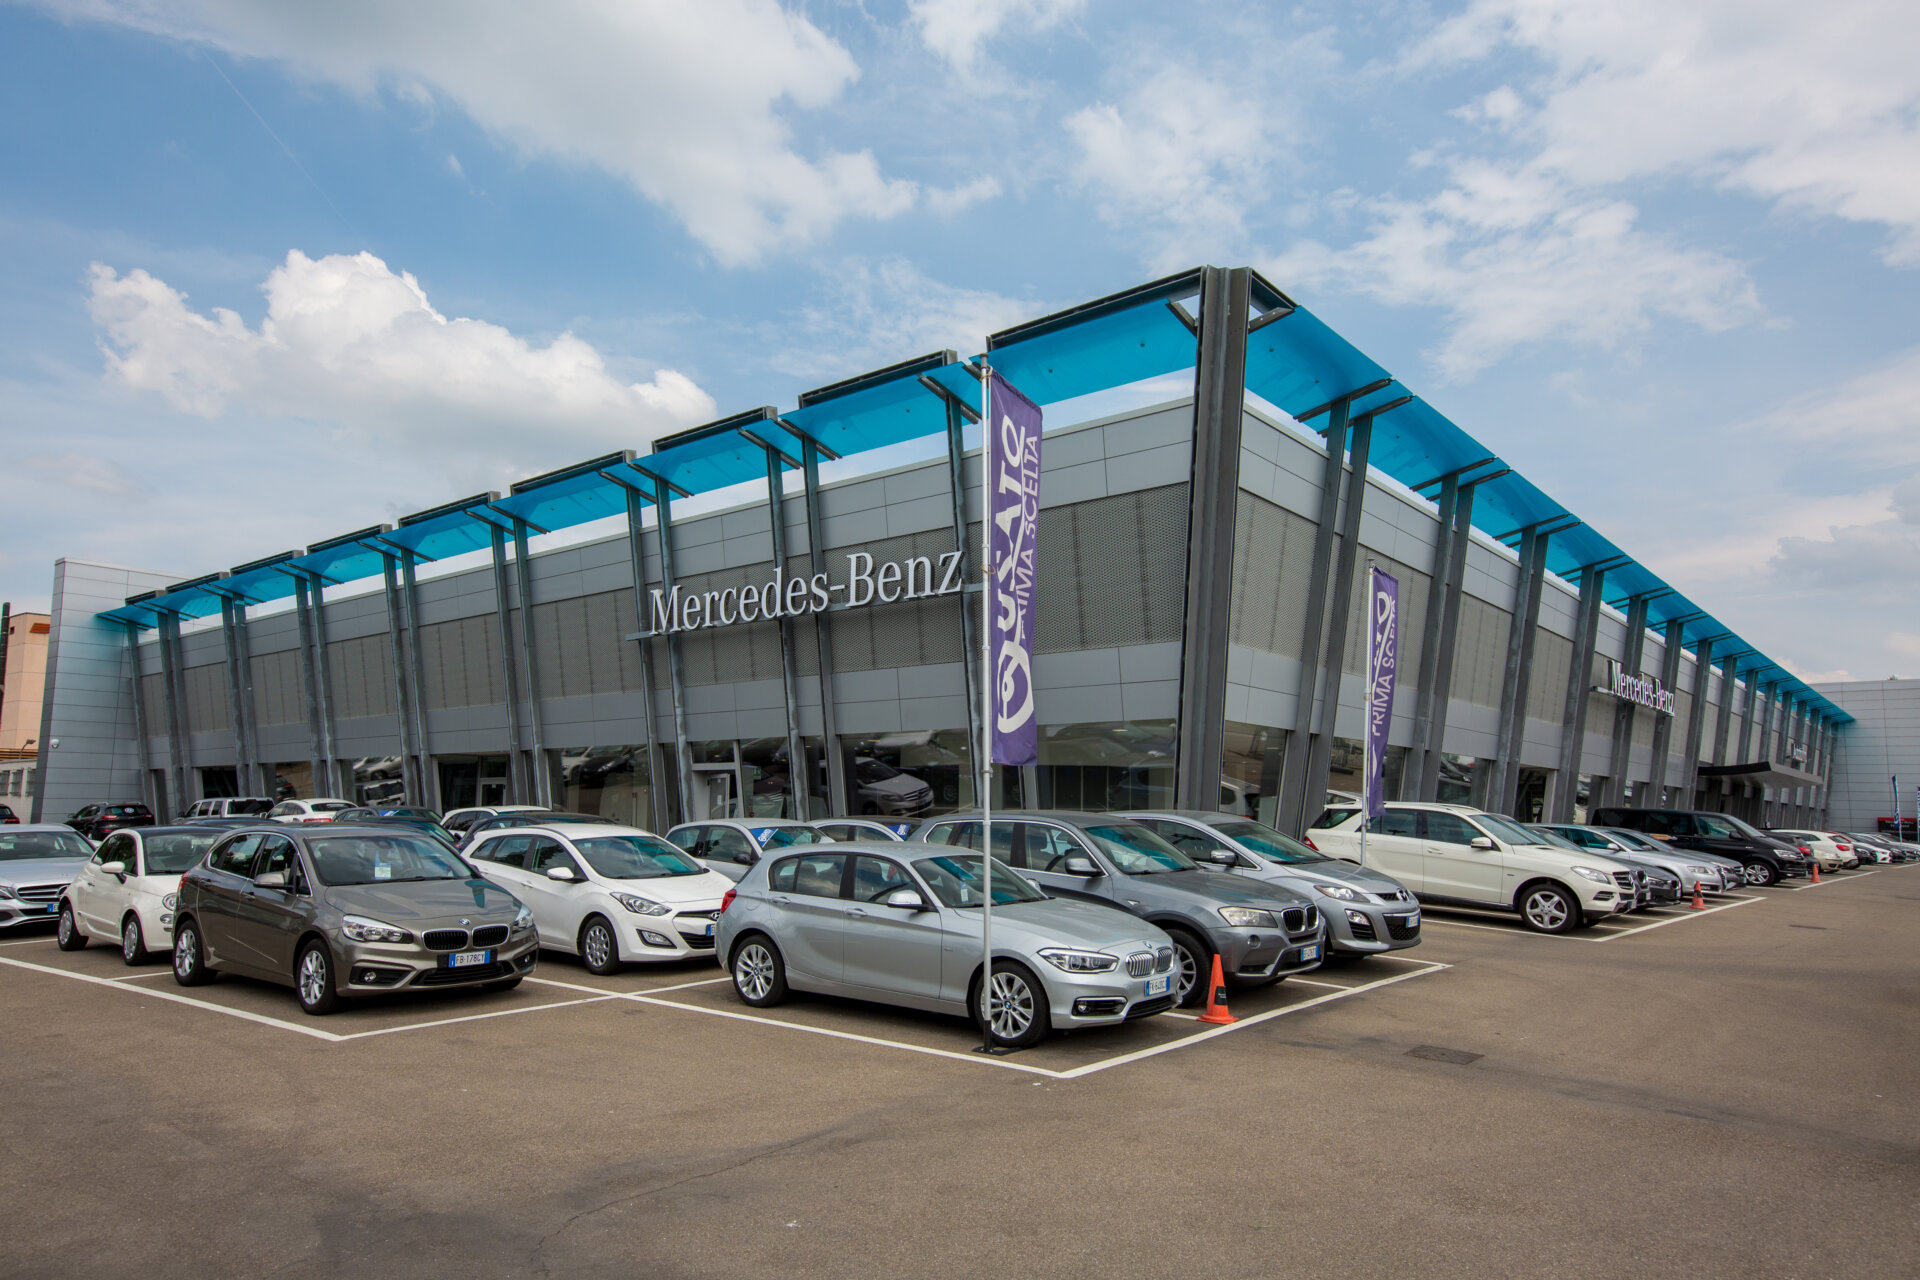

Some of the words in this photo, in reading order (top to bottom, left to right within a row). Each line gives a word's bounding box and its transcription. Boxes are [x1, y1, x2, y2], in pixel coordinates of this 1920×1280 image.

[1022, 436, 1038, 539] SCELTA
[648, 550, 965, 636] Mercedes-Benz
[1611, 660, 1675, 716] Mercedes-Benz
